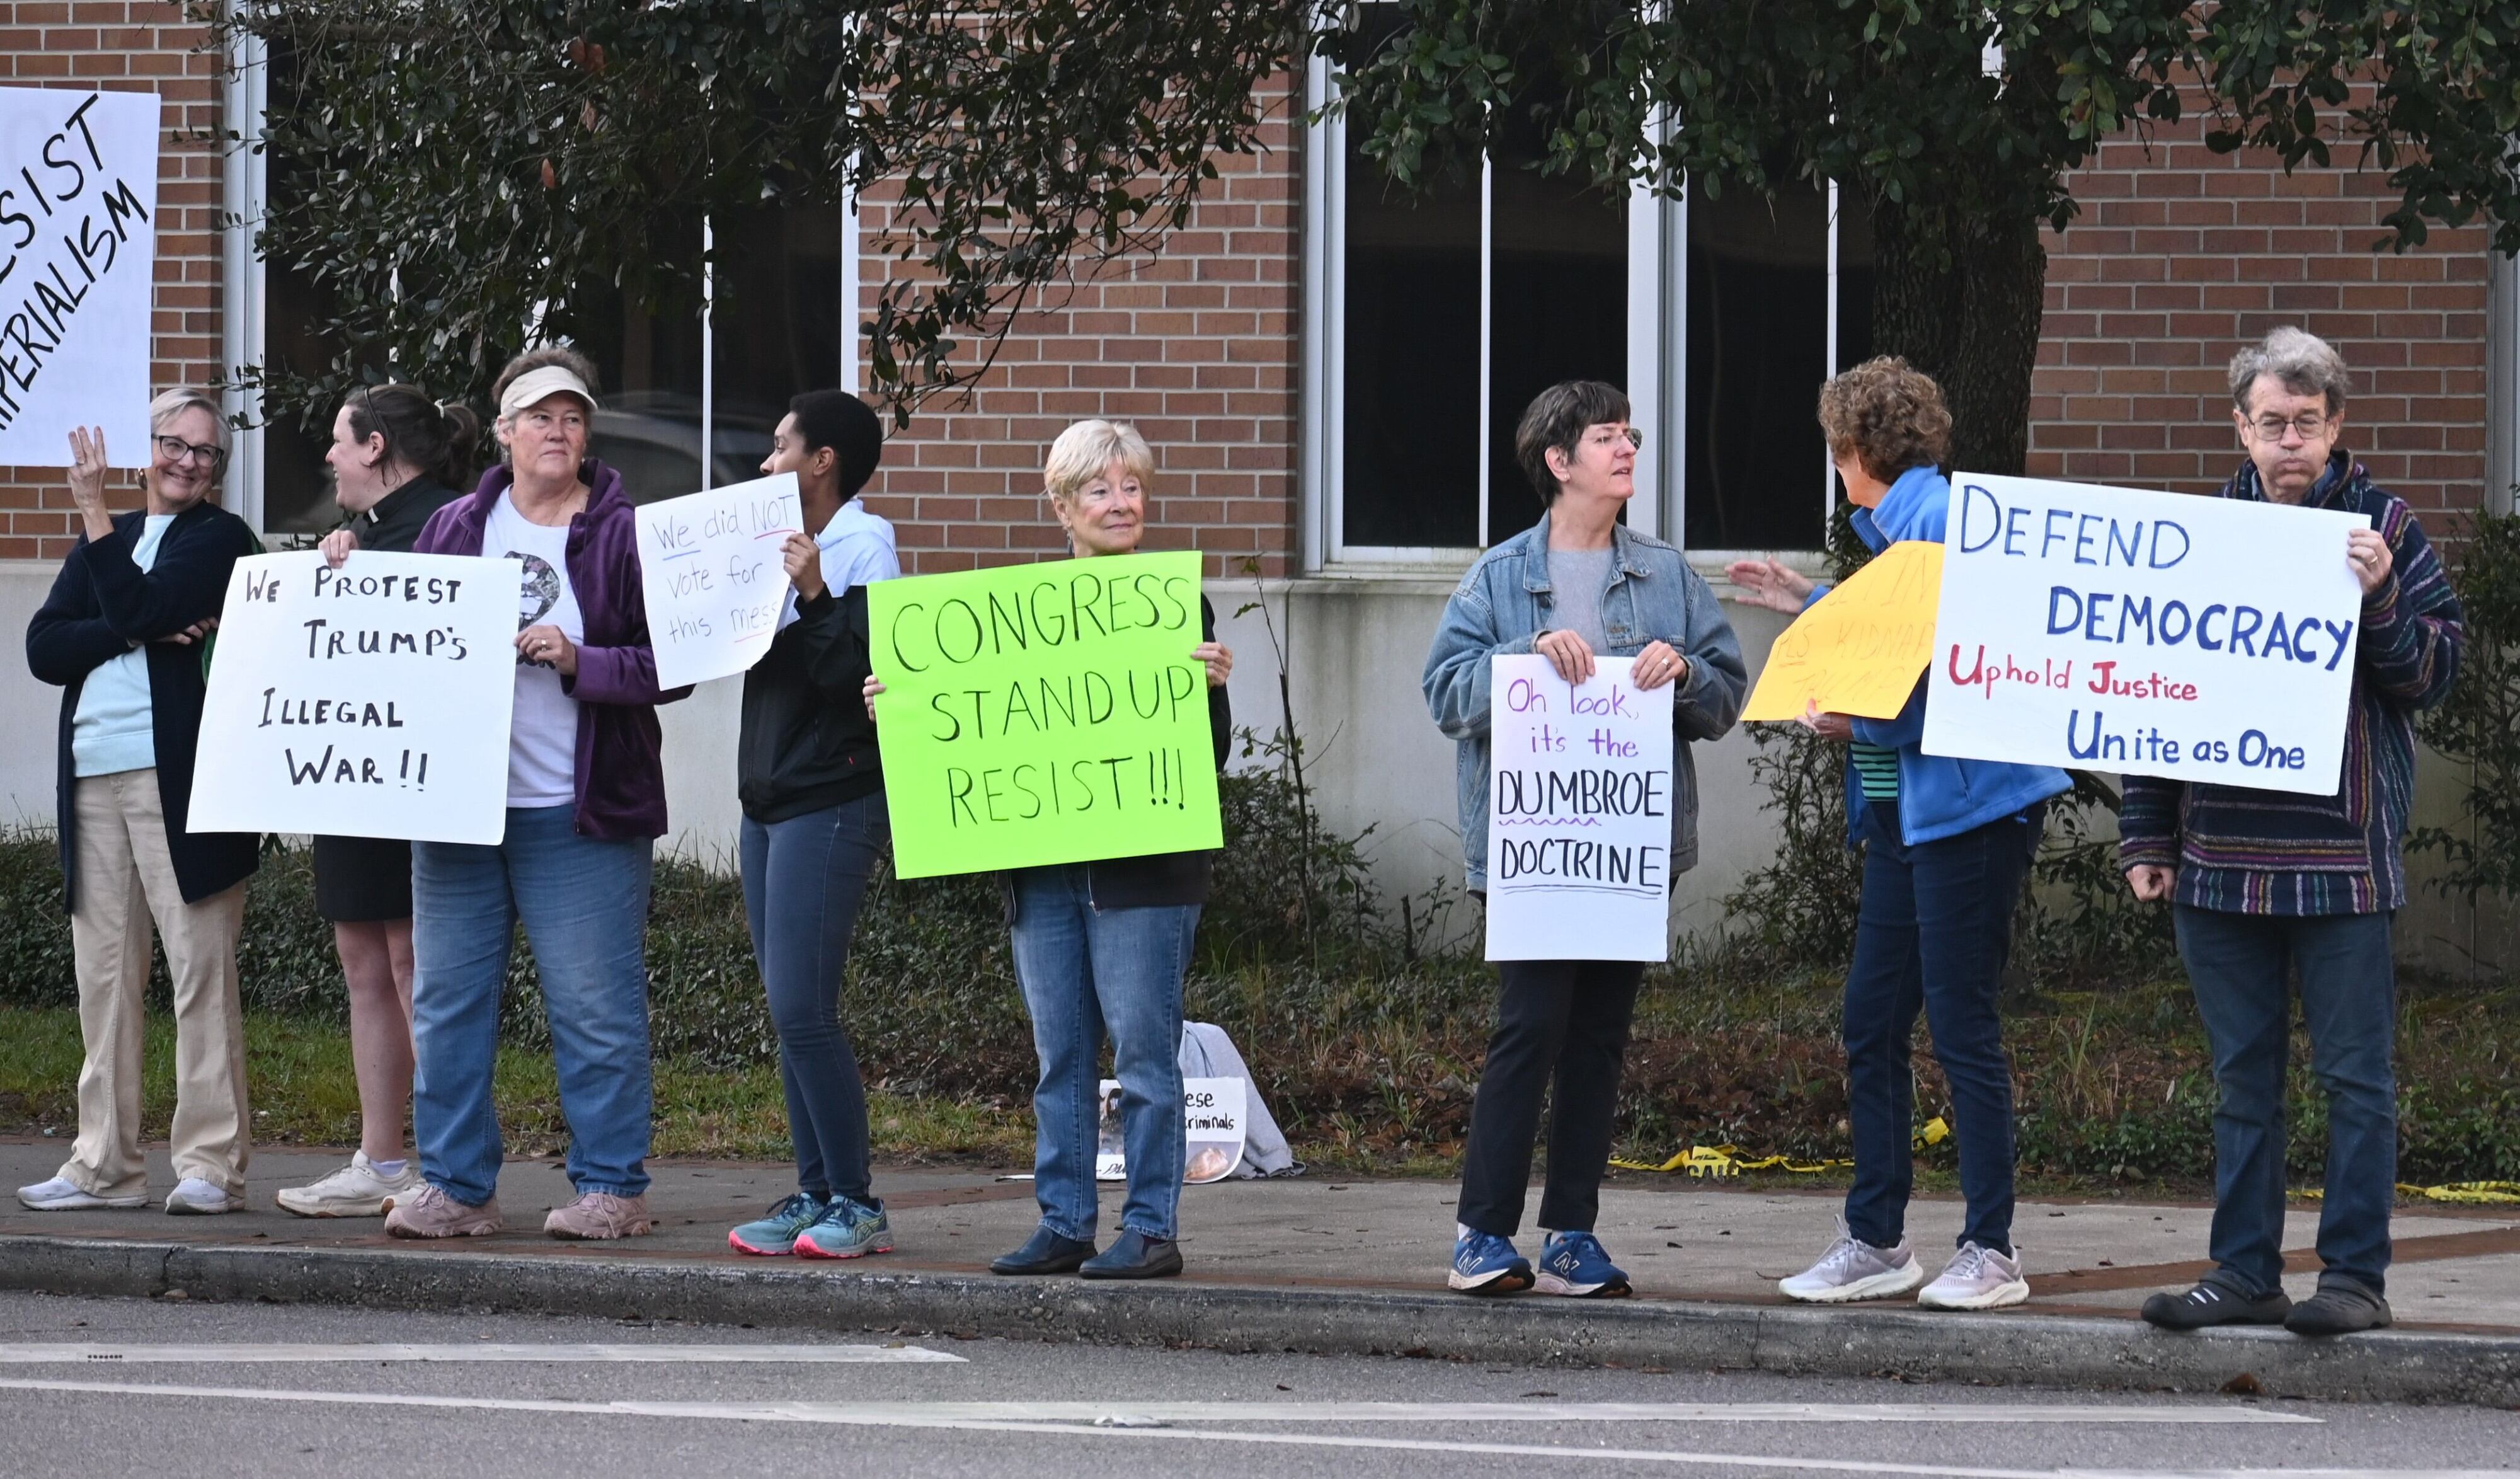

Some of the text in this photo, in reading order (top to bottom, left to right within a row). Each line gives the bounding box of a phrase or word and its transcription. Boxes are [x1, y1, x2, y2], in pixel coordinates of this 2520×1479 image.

[0, 93, 103, 284] SIST
[651, 493, 795, 551] We did NOT
[1960, 485, 2190, 568] DEFEND
[246, 565, 461, 604] WE PROTEST
[726, 554, 764, 585] for
[668, 614, 712, 644] this
[892, 573, 1189, 672] CONGRESS
[2046, 585, 2354, 671] DEMOCRACY
[1508, 679, 1546, 712] Oh
[1949, 644, 2197, 701] Uphold Justice
[258, 688, 403, 728] ILLEGAL
[932, 666, 1193, 742] STAND UP
[1532, 724, 1638, 757] it's the
[2067, 709, 2305, 769] Unite as One
[1498, 769, 1668, 817] DUMBROE
[1501, 838, 1664, 887] DOCTRINE
[1185, 1093, 1214, 1107] ese
